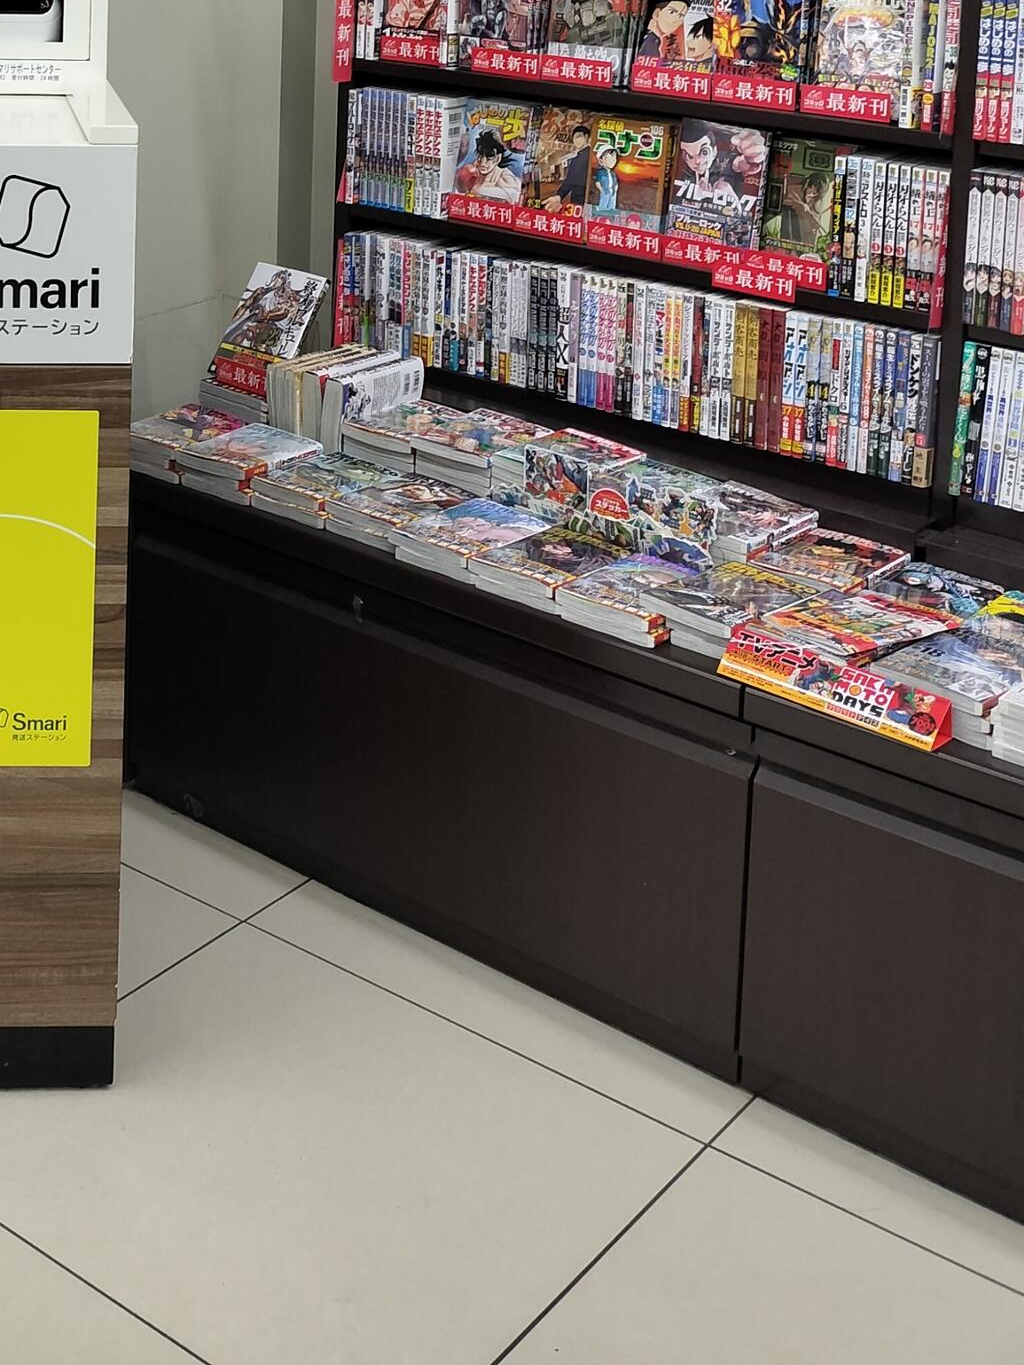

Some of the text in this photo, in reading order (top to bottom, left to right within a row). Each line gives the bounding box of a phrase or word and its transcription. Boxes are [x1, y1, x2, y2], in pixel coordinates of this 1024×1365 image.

[399, 42, 441, 60] 最新刊
[491, 53, 538, 74] 最新刊
[560, 62, 612, 83] 最新刊
[653, 75, 709, 98] 最新刊
[735, 83, 793, 107] 最新刊
[826, 92, 889, 117] 最新刊
[595, 130, 664, 160] コナン
[467, 203, 513, 224] 最新刊
[532, 217, 582, 239] 最新刊
[607, 232, 660, 254] 最新刊
[683, 245, 740, 265] 最新刊
[734, 272, 793, 297] 最新刊
[832, 691, 886, 719] DAYS
[12, 712, 67, 731] Smari
[12, 733, 66, 742] 発送ステーション
